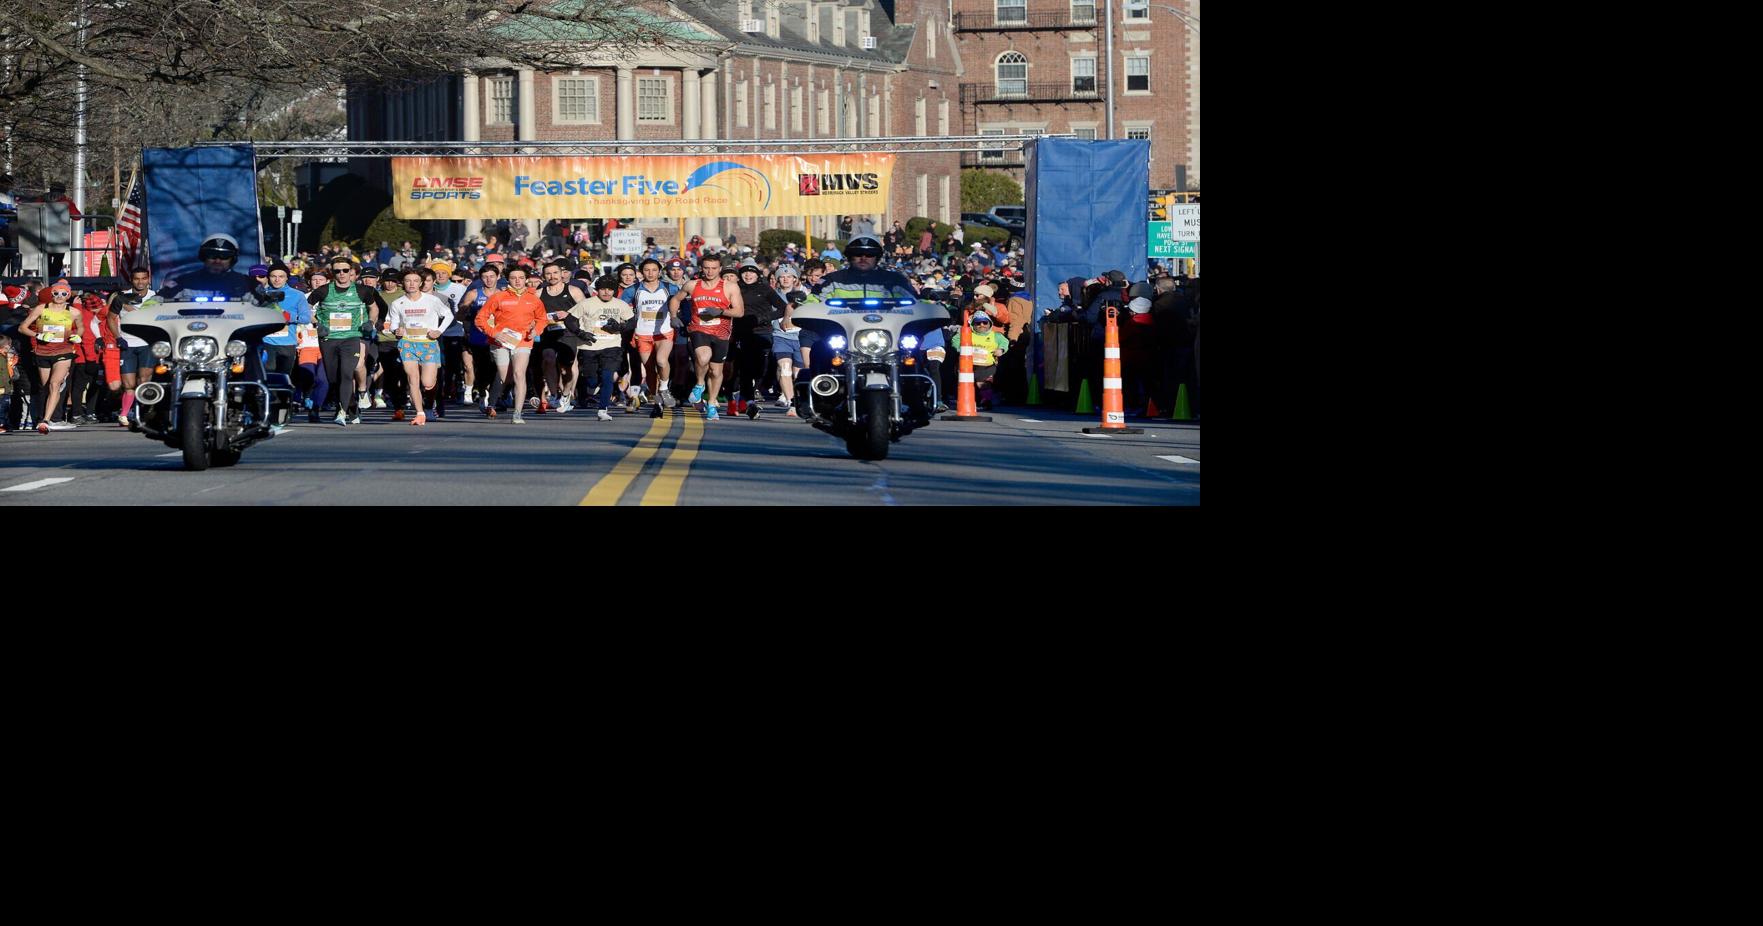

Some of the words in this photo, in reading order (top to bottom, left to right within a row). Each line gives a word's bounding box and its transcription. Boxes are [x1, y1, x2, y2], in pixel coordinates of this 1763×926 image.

[514, 175, 618, 196] Feaster
[622, 174, 679, 196] Five
[410, 191, 481, 200] SPORTS
[589, 196, 650, 206] Thanksgiving
[653, 196, 672, 206] Day
[703, 196, 728, 204] Race
[1154, 245, 1171, 253] NEXT
